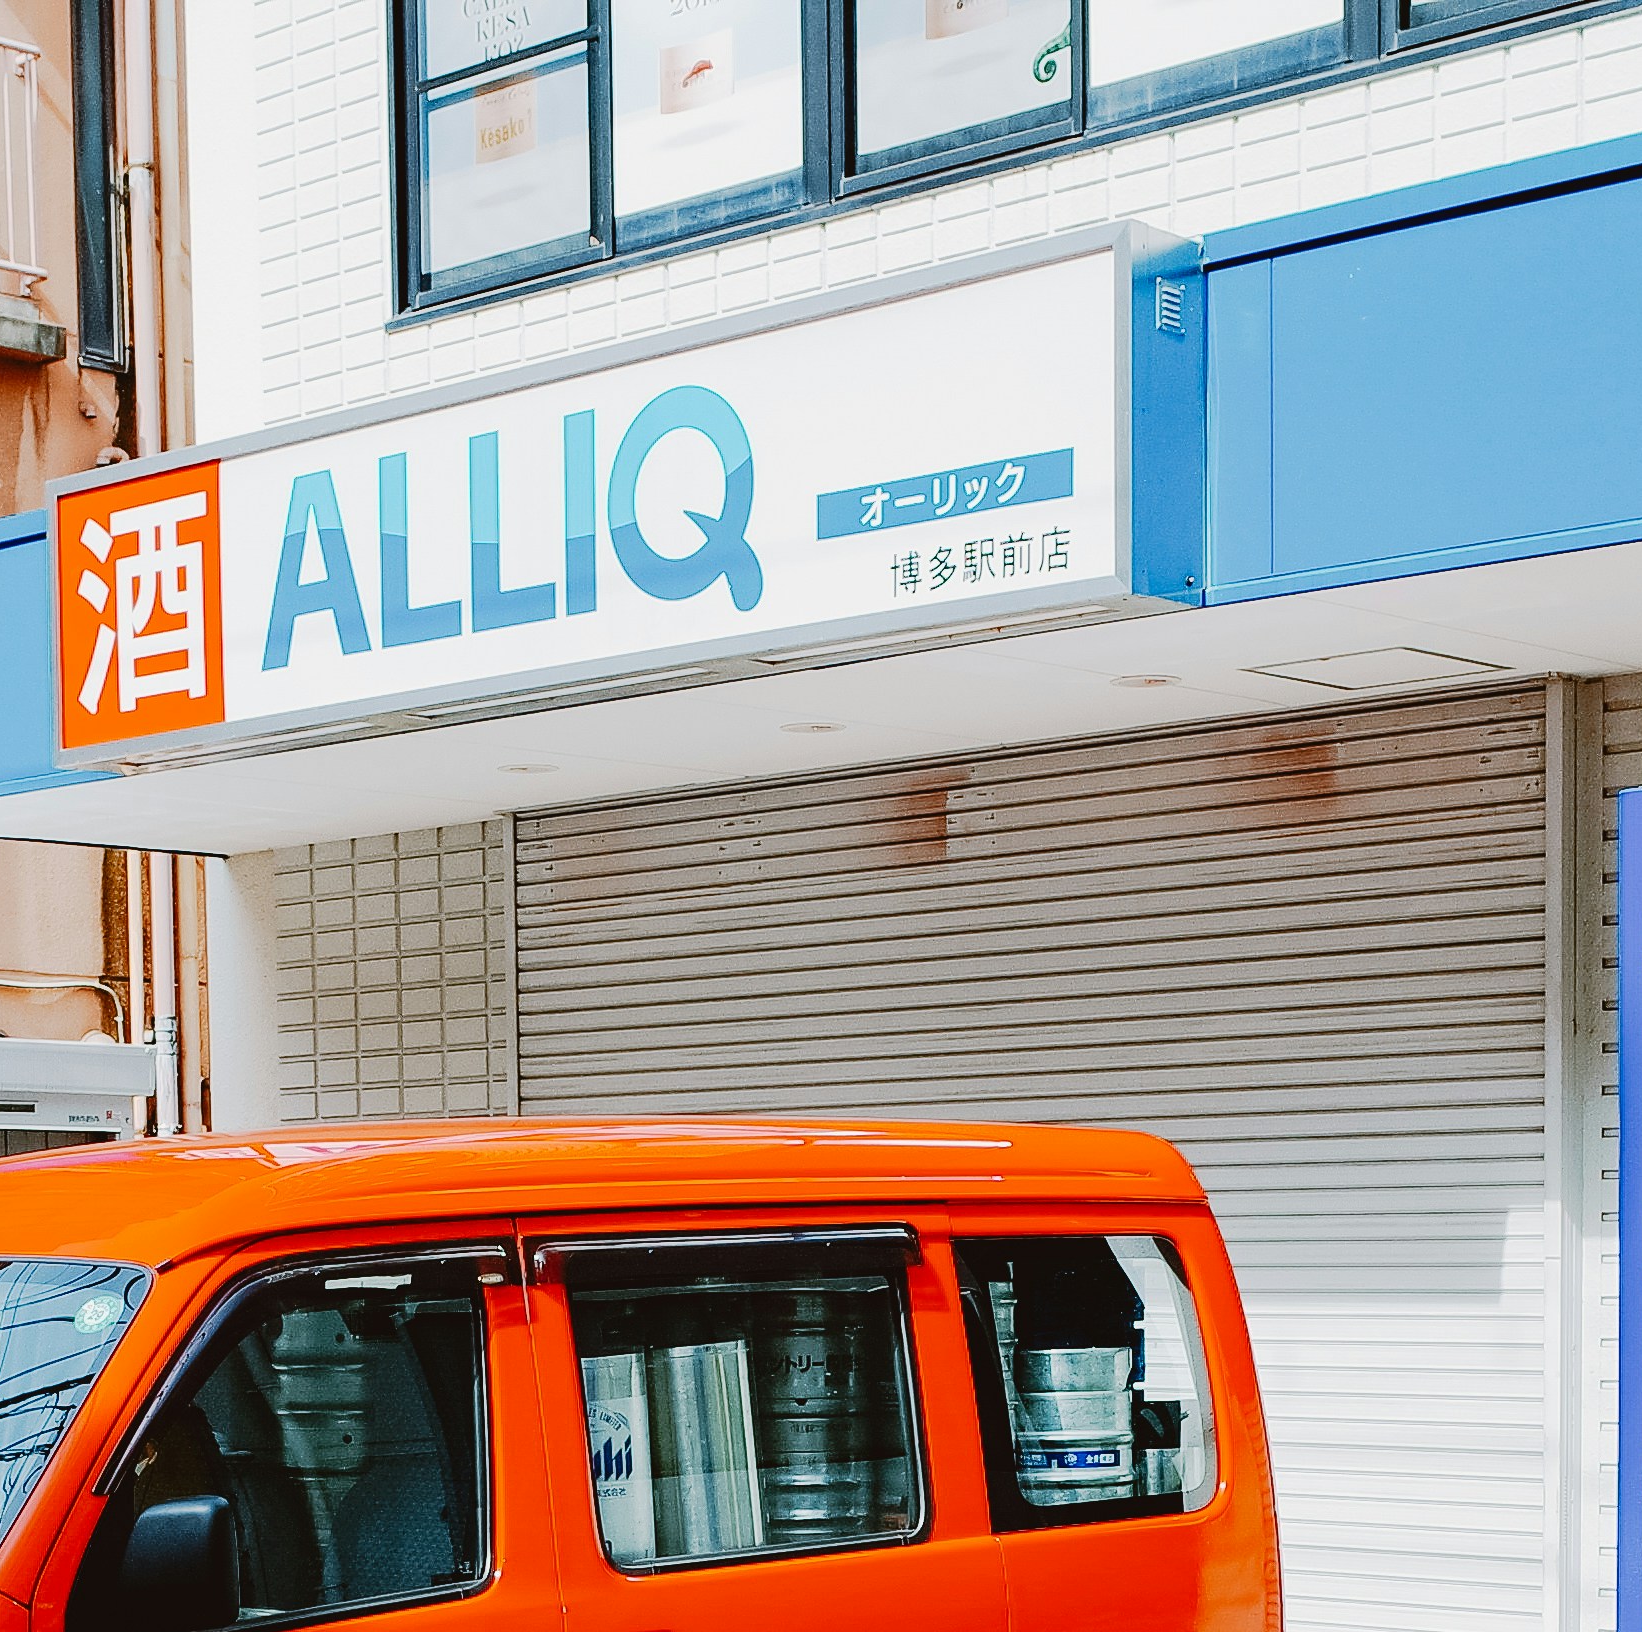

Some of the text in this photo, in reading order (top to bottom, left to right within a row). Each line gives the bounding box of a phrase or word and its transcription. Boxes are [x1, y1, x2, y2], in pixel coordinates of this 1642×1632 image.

[262, 384, 763, 672] ALLIQ
[859, 460, 1029, 528] オーリック
[889, 525, 1072, 597] 博多駅前店
[77, 491, 208, 715] 酒
